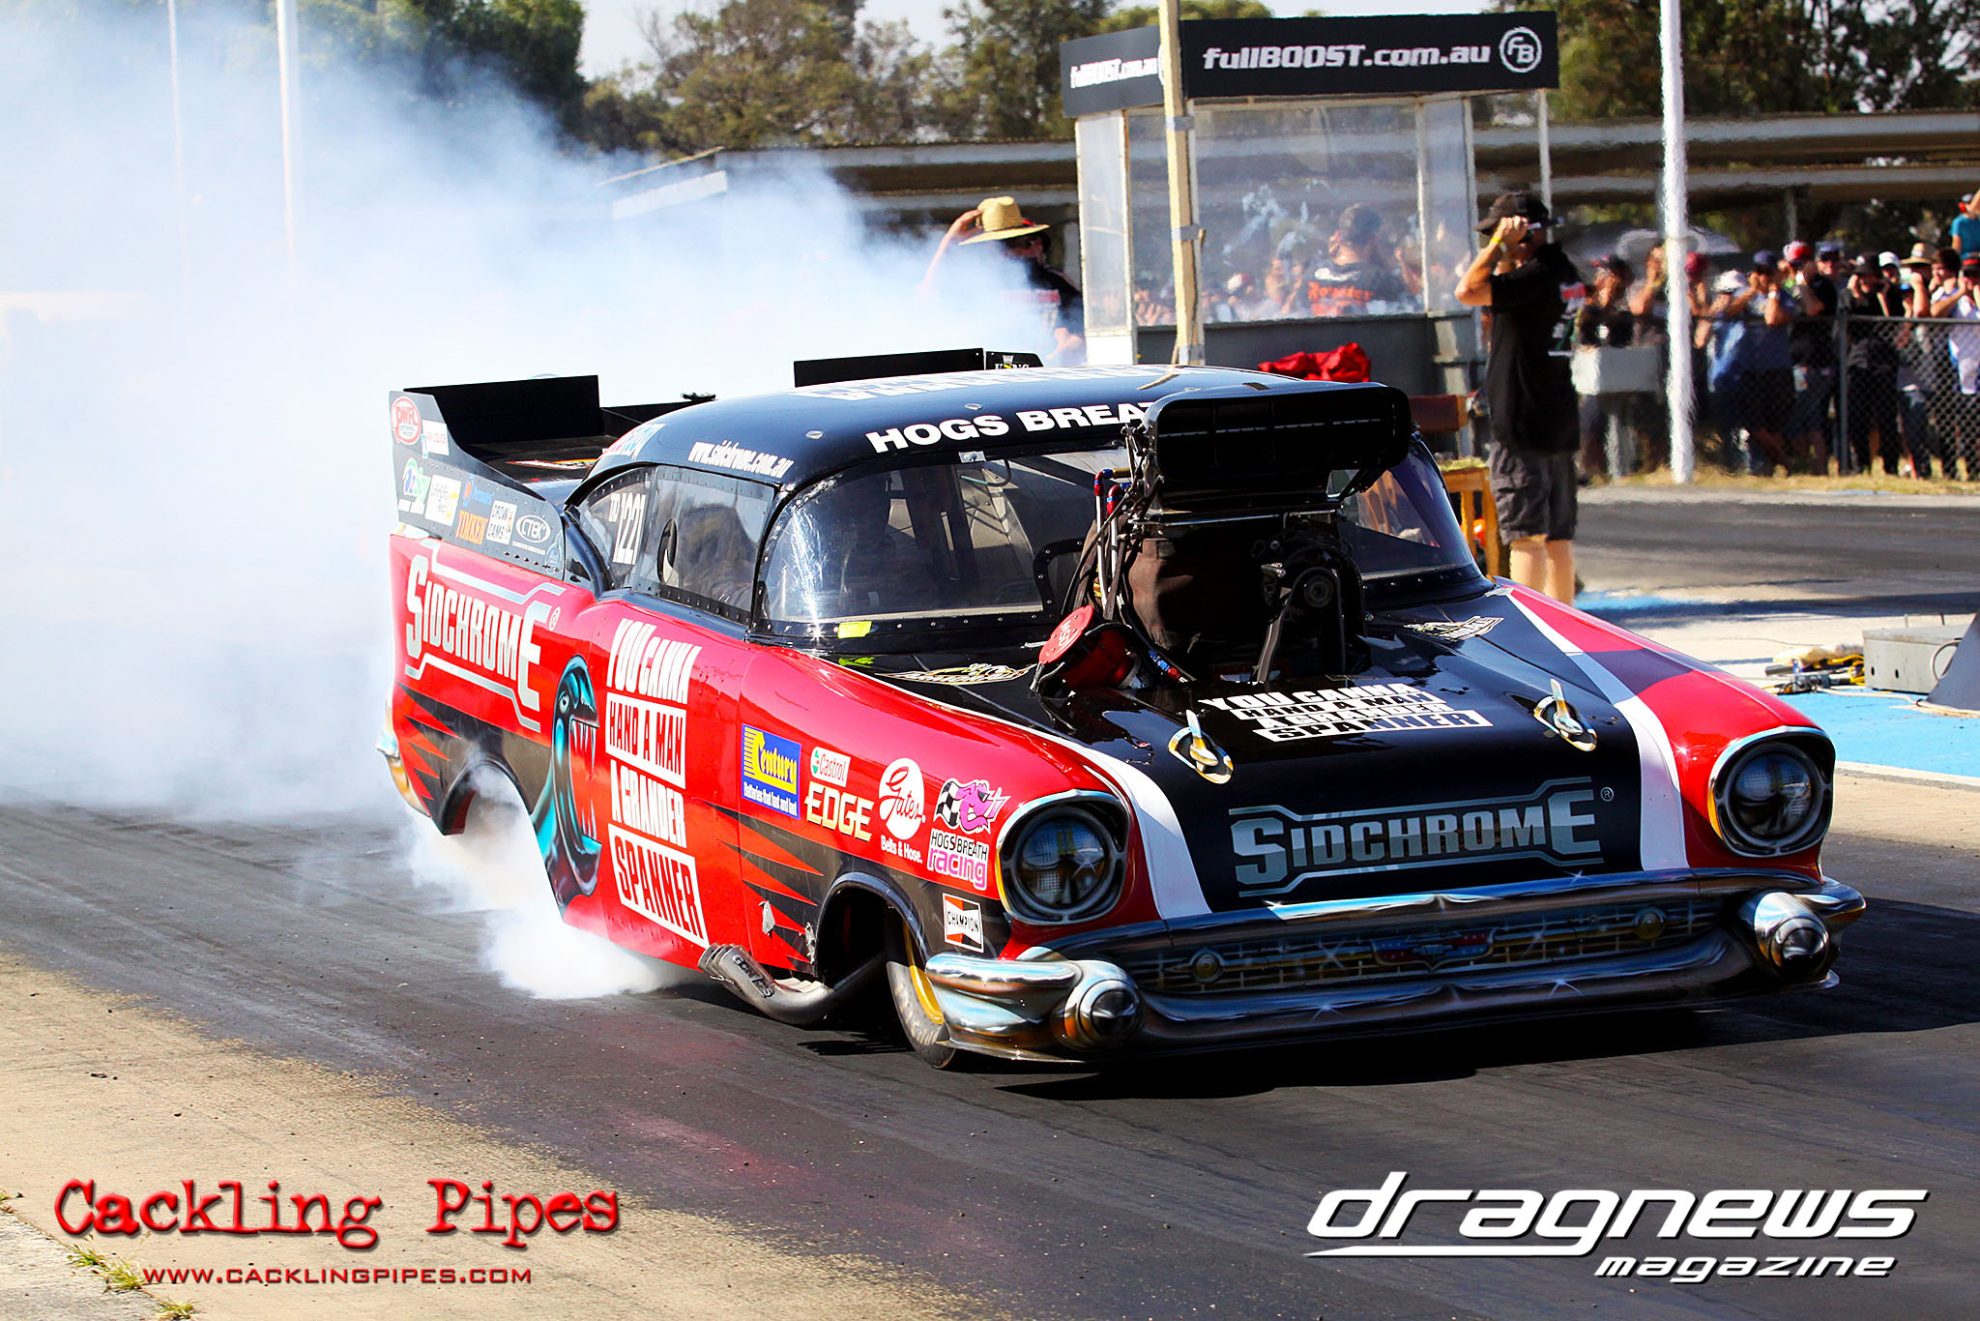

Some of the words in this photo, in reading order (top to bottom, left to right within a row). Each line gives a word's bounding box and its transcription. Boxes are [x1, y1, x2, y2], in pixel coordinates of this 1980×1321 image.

[1203, 45, 1490, 70] fullBOOST.com.au
[865, 415, 1010, 454] HOGS
[406, 554, 552, 712] SIDCHROME
[607, 618, 657, 693] YOU
[638, 637, 702, 704] CANNA
[1198, 692, 1296, 710] YOU
[1292, 683, 1421, 703] CANNA
[1241, 704, 1325, 718] HAND
[1333, 701, 1355, 710] A
[1360, 693, 1433, 707] MAN
[1285, 703, 1455, 725] GRANDER
[610, 701, 639, 756] HAND
[643, 710, 650, 761] A
[656, 712, 683, 775] MAN
[1269, 713, 1480, 738] SPANNER
[744, 727, 798, 795] Century
[819, 752, 847, 783] Castrol
[610, 759, 621, 822] A
[621, 765, 687, 848] GRANDER
[804, 781, 875, 842] EDGE
[931, 830, 956, 851] HOGS
[957, 837, 988, 861] BREATH
[1230, 789, 1600, 885] SIDCHROME
[614, 835, 704, 939] SPANNER
[928, 848, 987, 890] racing
[947, 911, 979, 933] CHAMPION
